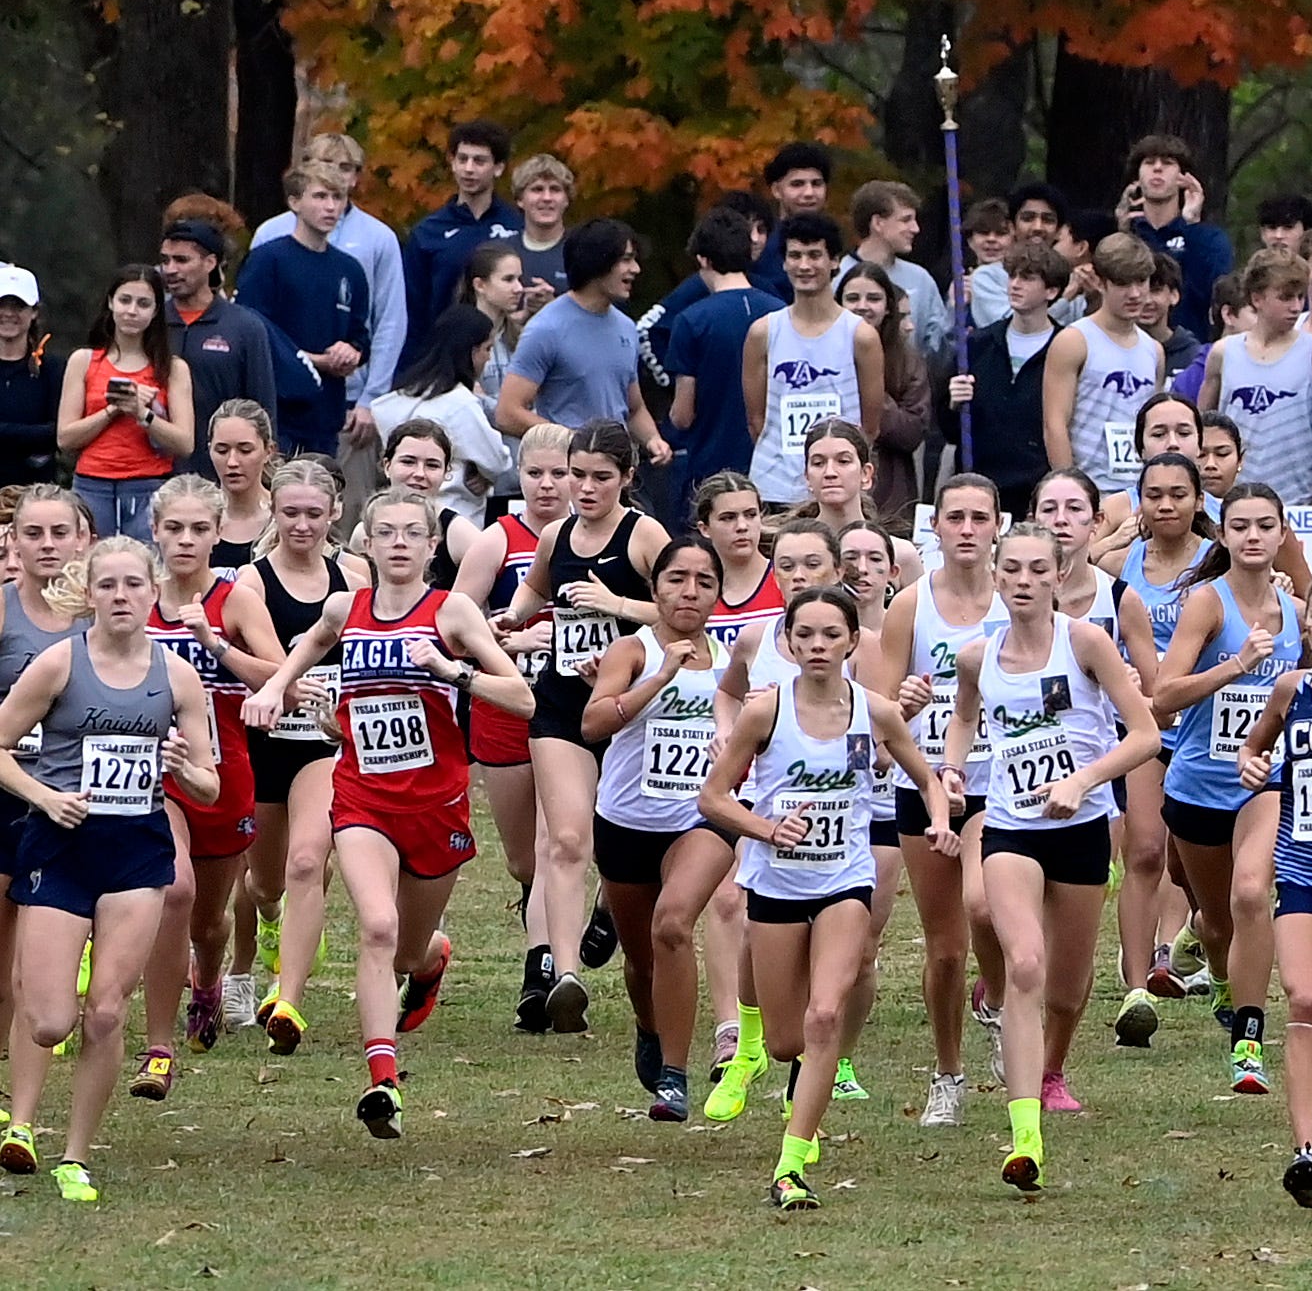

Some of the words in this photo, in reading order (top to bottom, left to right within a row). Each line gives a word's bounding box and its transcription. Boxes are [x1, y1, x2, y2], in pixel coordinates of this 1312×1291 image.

[563, 622, 615, 654] 1241
[342, 640, 416, 671] EAGLE
[931, 695, 951, 704] SSAA
[1221, 692, 1249, 703] TSSAA
[354, 704, 381, 715] TSSAA
[382, 702, 407, 713] STATE
[77, 707, 158, 735] Knights
[993, 705, 1062, 732] Irish
[358, 715, 426, 751] 1298
[652, 727, 680, 738] TSSAA
[682, 729, 705, 740] STATE
[119, 743, 143, 754] STATE
[1002, 745, 1028, 759] TSSAA
[364, 749, 429, 766] CHAMPIONSHIPS
[89, 757, 152, 791] 1278
[786, 760, 857, 792] Irish
[1007, 749, 1077, 795] 1229
[86, 794, 149, 806] CHAMPIONSHIPS
[813, 799, 836, 811] STATE
[797, 815, 845, 849] 231
[776, 850, 846, 862] CHAMPIONSHIPS
